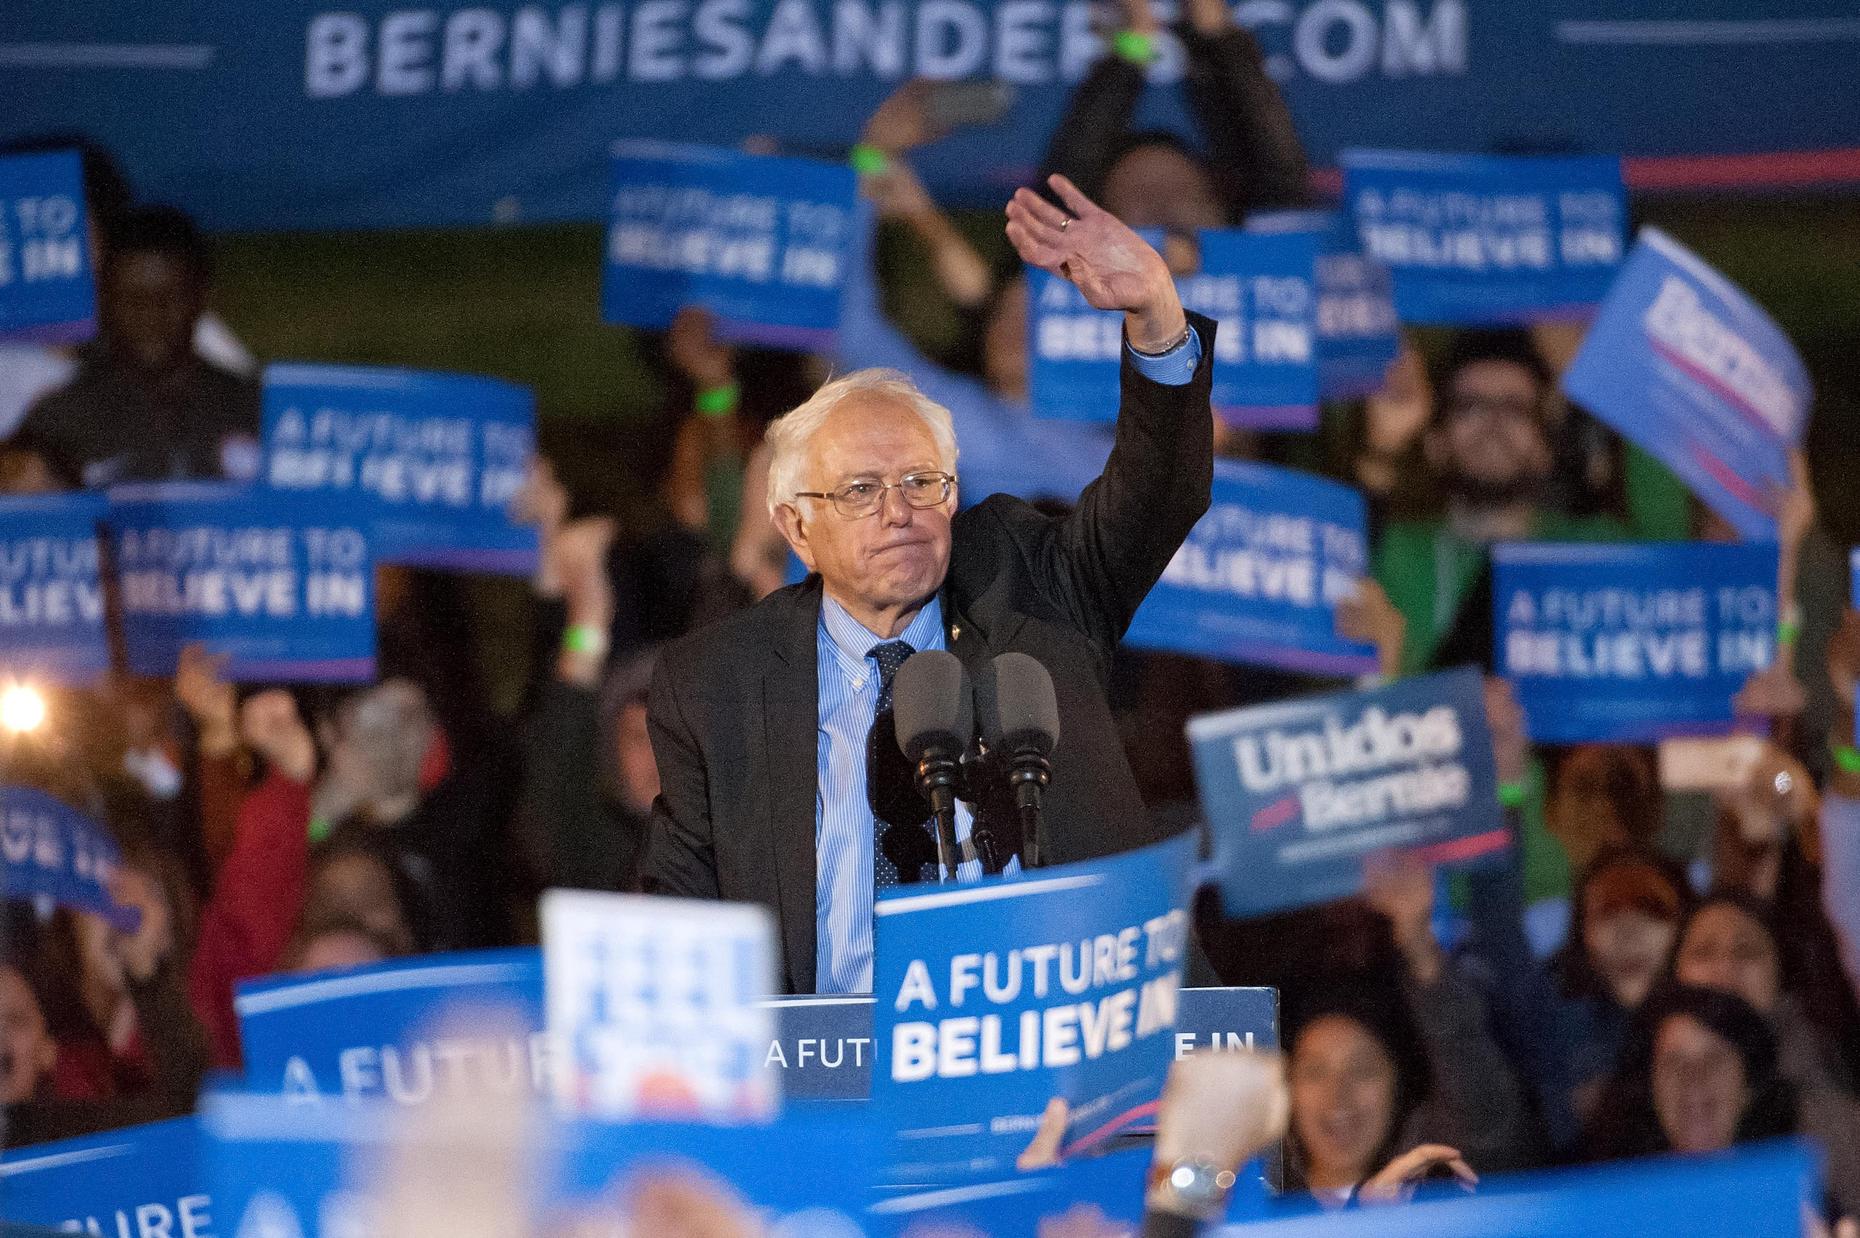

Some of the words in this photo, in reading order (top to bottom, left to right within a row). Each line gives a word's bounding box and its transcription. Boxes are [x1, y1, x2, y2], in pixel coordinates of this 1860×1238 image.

[304, 526, 367, 569] TO
[304, 571, 367, 619] IN
[1507, 587, 1537, 625] A
[1541, 585, 1706, 629] FUTURE
[1716, 584, 1774, 623] TO
[1504, 628, 1709, 679] BELIEVE
[1716, 629, 1773, 674] IN
[1233, 706, 1463, 792] Unidos
[1301, 763, 1470, 833] Bernie
[895, 957, 939, 1012] A
[949, 924, 1144, 1010] FUTURE
[763, 1039, 789, 1068] A
[798, 1037, 878, 1068] FUT
[890, 987, 1138, 1083] BELIEVE
[281, 1054, 322, 1105] A
